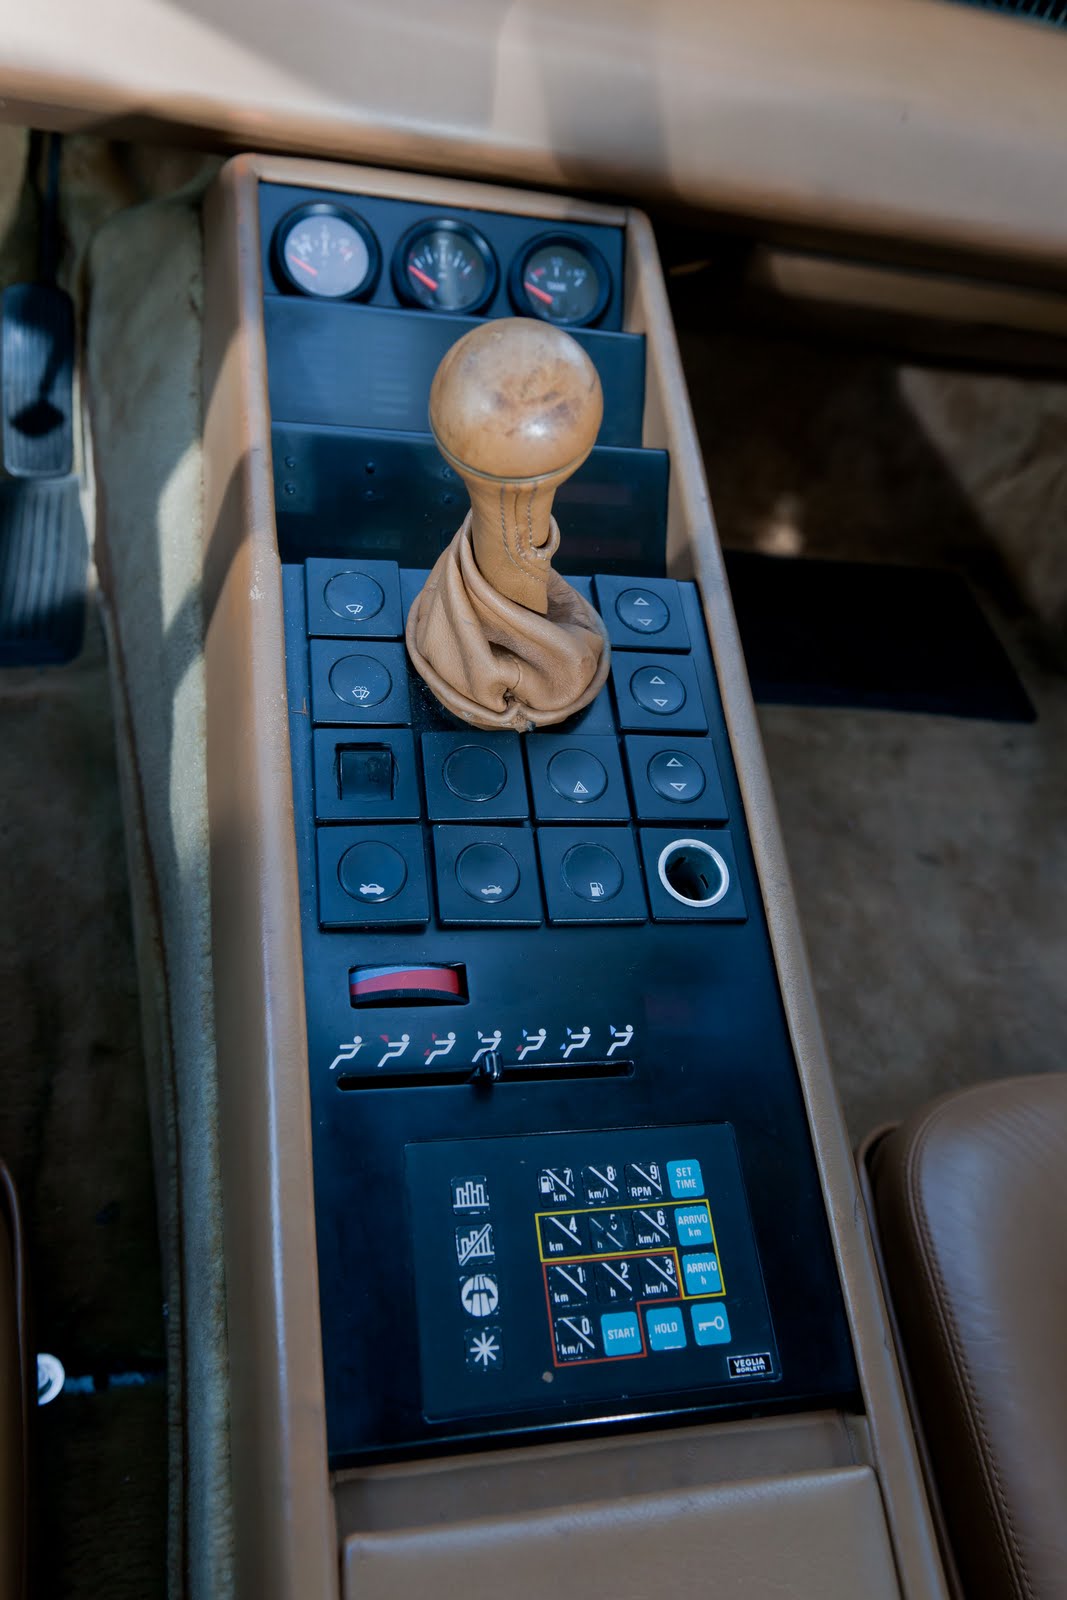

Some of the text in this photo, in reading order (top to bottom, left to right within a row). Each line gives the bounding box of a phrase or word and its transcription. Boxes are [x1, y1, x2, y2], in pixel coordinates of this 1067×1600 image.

[607, 1166, 615, 1181] 8
[650, 1165, 658, 1180] 9
[676, 1167, 691, 1177] SET
[564, 1170, 571, 1185] 7
[676, 1179, 696, 1189] TIME
[554, 1192, 567, 1202] km
[588, 1189, 609, 1198] km/l
[631, 1187, 651, 1197] RPM
[657, 1211, 665, 1225] 6
[678, 1214, 707, 1225] ARRIVO
[569, 1217, 577, 1232] 4
[689, 1228, 701, 1237] km
[638, 1234, 660, 1244] km/h
[549, 1242, 563, 1251] km
[621, 1263, 628, 1278] 2
[665, 1259, 673, 1274] 3
[687, 1261, 717, 1273] ARRIVO
[701, 1276, 706, 1285] h
[610, 1288, 615, 1297] h
[645, 1284, 668, 1294] km/h
[555, 1293, 569, 1302] km
[582, 1319, 589, 1334] 0
[654, 1323, 678, 1334] HOLD
[608, 1327, 635, 1339] START
[561, 1344, 583, 1354] km/l
[733, 1357, 765, 1367] VEGLIA
